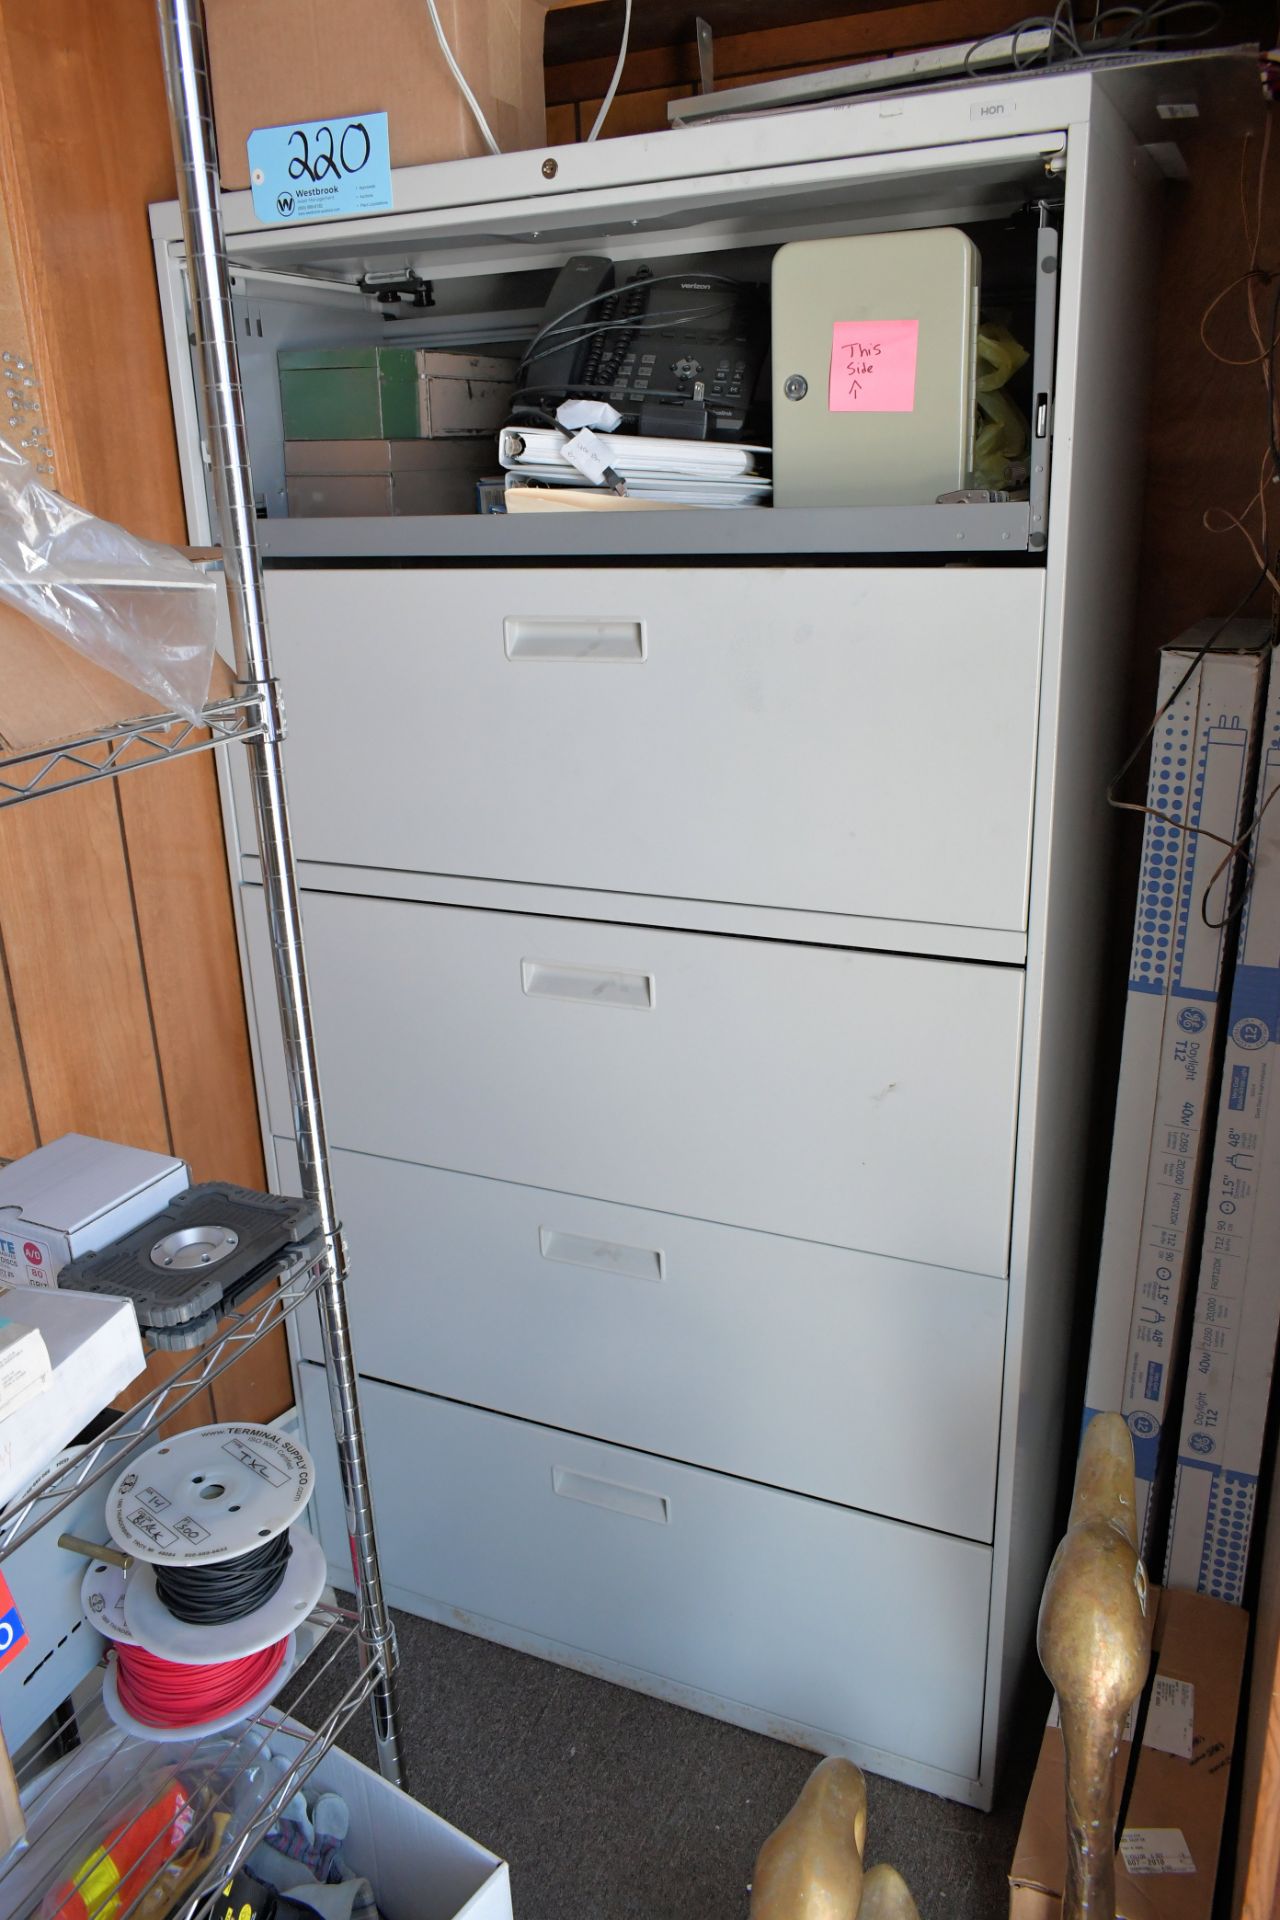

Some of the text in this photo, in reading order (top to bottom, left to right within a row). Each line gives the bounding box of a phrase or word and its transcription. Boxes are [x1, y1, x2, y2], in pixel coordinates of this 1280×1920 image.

[288, 123, 370, 182] 220
[296, 186, 339, 197] Westbrook
[681, 282, 711, 290] verizon
[841, 343, 881, 358] This
[847, 362, 873, 376] Side
[1245, 1026, 1257, 1040] 12
[1174, 1041, 1188, 1061] T12
[1184, 1042, 1200, 1081] Daylight
[31, 1268, 43, 1279] 80
[1194, 1392, 1208, 1426] Daylight
[1205, 1409, 1218, 1427] T12
[227, 1427, 282, 1444] TERMINAL
[281, 1442, 307, 1470] SUPPLY
[148, 1496, 166, 1508] 14
[132, 1513, 164, 1540] BLACK
[176, 1523, 200, 1539] 500
